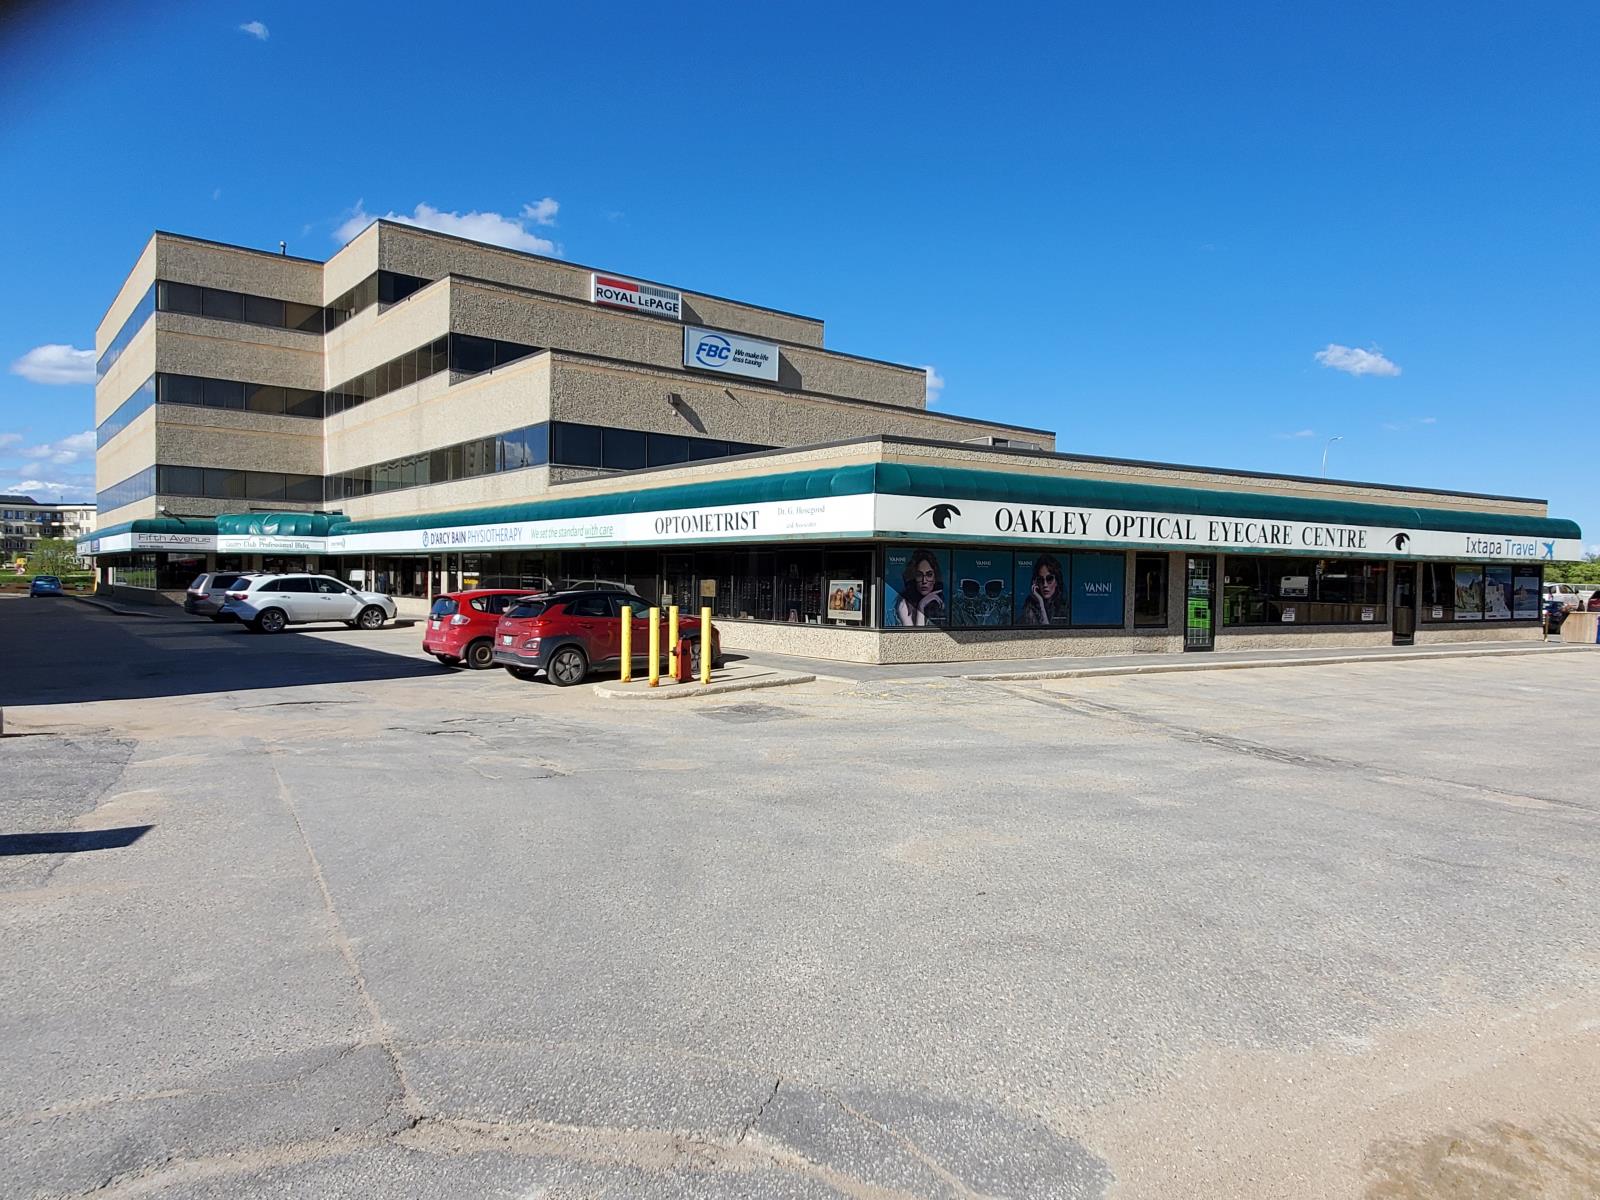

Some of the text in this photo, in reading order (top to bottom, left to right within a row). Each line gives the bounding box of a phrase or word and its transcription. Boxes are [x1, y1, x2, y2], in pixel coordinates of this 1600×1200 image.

[596, 287, 635, 305] ROYAL
[696, 342, 731, 360] FBC
[734, 348, 769, 361] We make life
[732, 355, 762, 368] less taxing
[530, 527, 540, 539] We
[558, 524, 584, 538] standard
[599, 525, 614, 536] care
[655, 510, 760, 535] OPTOMETRIST
[995, 507, 1367, 549] OAKLEY OPTICAL EYECARE CENTRE
[138, 533, 211, 543] Fifth Avenue
[430, 527, 523, 545] D'ARCY BAIN PHYSIOTHERAPY
[1465, 536, 1538, 558] Ixtapa Travel
[1084, 582, 1112, 593] VANNI
